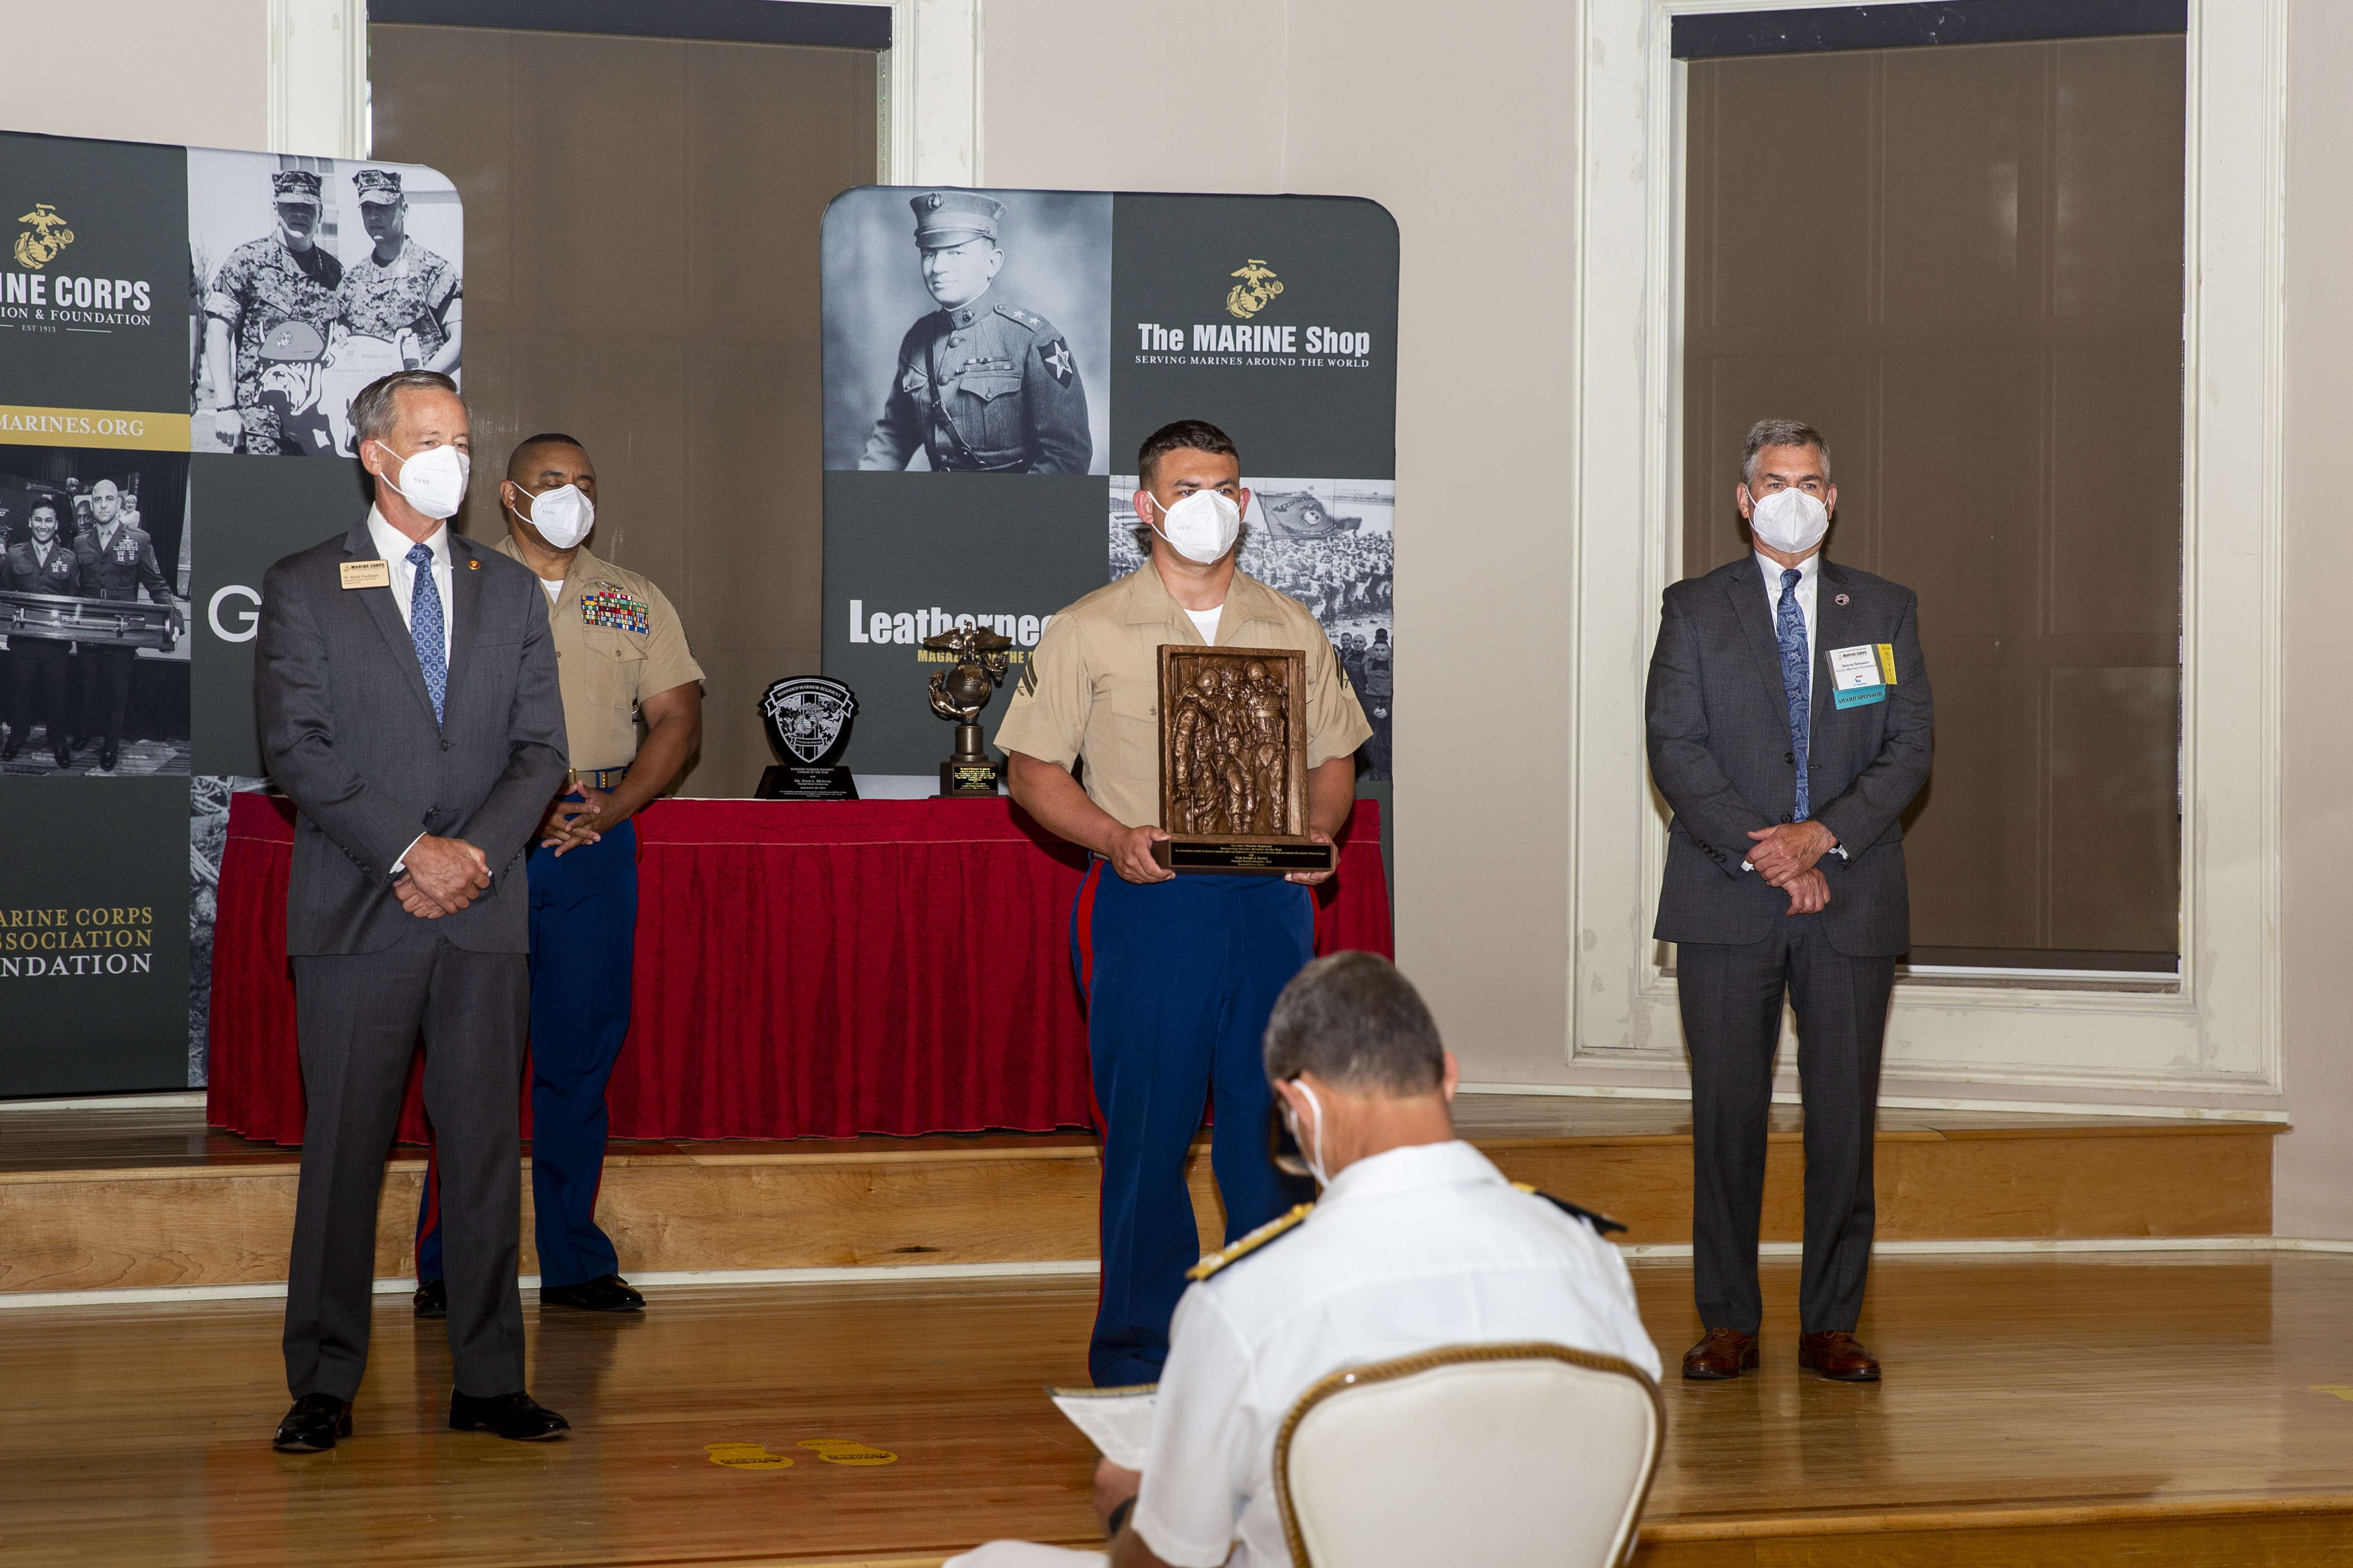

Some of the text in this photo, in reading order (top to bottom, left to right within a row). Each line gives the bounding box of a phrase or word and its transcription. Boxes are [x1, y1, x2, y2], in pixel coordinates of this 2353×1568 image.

[55, 276, 151, 312] CORPS
[1, 307, 151, 326] ION & FOUNDATION
[1138, 323, 1370, 357] The MARINE Shop
[1135, 355, 1369, 368] SERVING MARINES AROUND THE WORLD
[777, 686, 799, 697] WOUNDED
[820, 686, 842, 698] REGIMENT
[1857, 691, 1883, 701] SPONSOR
[76, 907, 152, 925] CORPS
[0, 929, 152, 950] SOCIATION
[0, 953, 152, 977] NDATION
